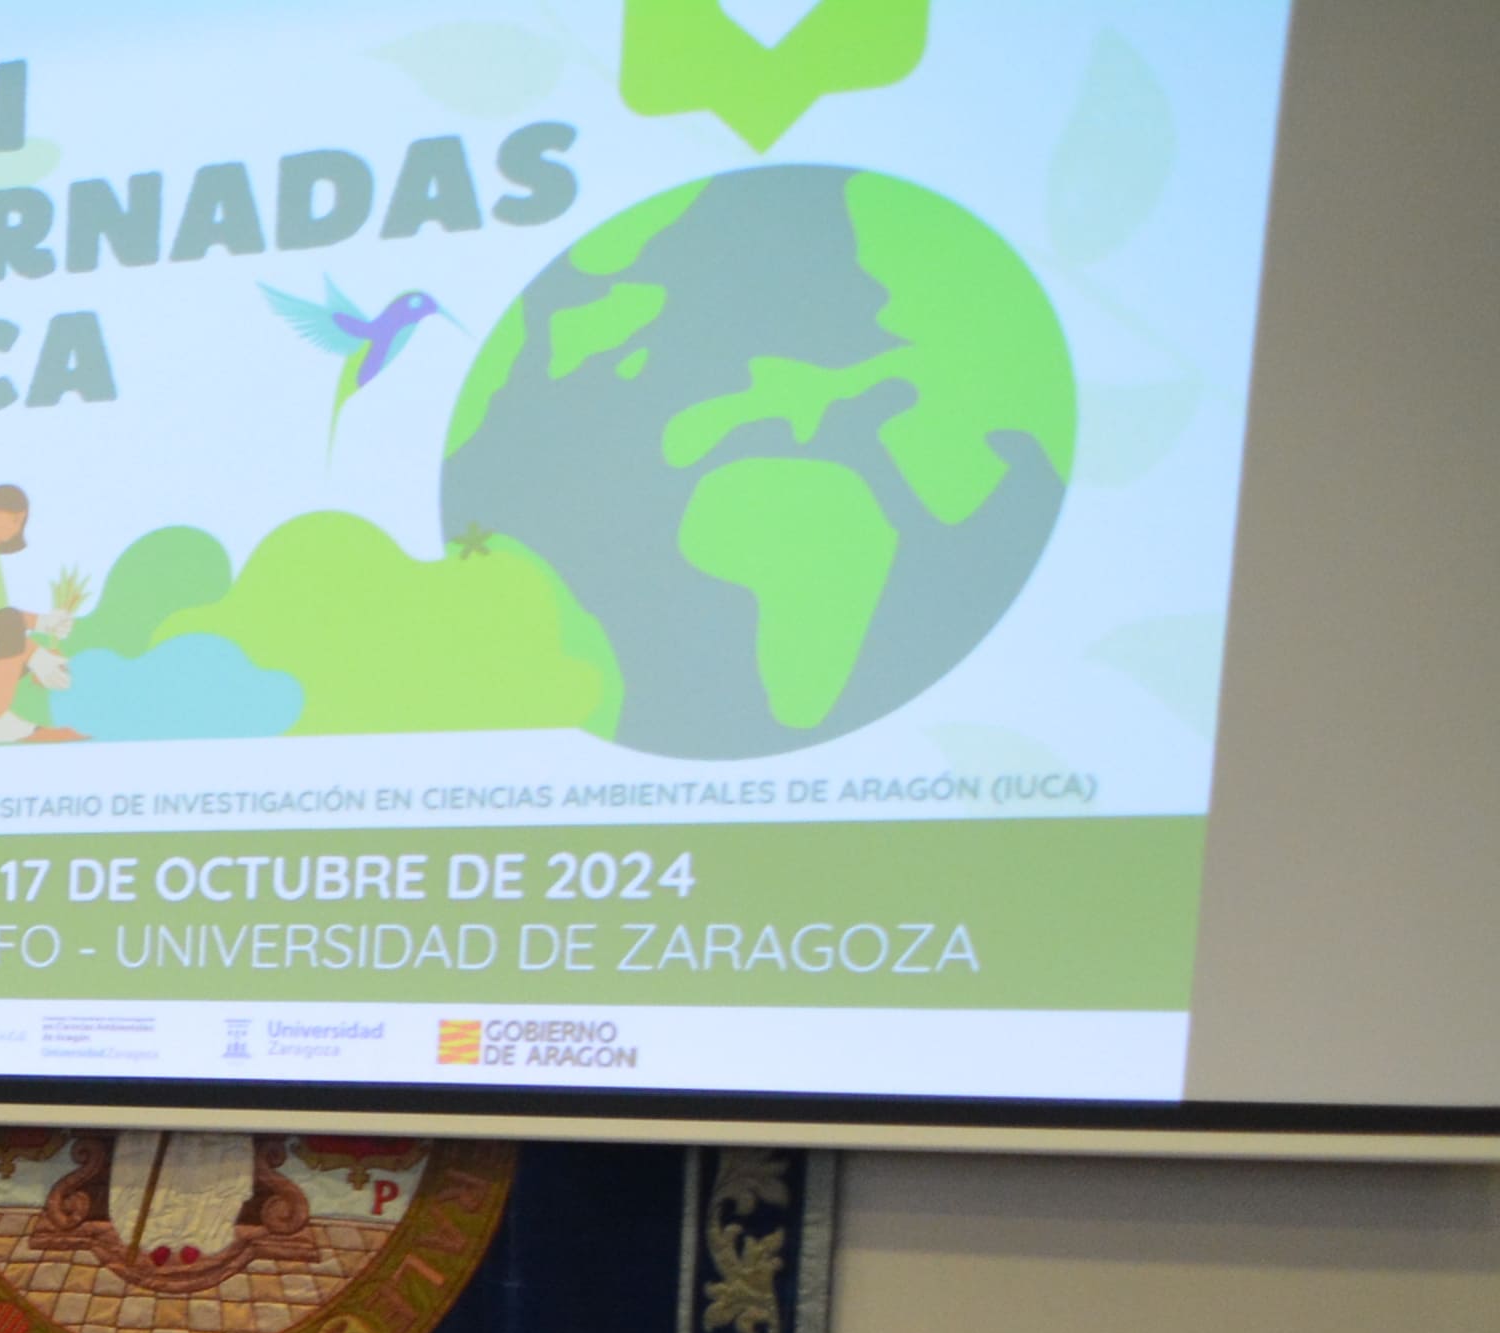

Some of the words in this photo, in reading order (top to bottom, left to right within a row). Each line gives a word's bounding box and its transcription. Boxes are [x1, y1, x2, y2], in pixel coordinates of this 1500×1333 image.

[110, 793, 145, 816] DE
[153, 785, 367, 815] INVESTIGACIÓN
[375, 788, 413, 811] EN
[422, 786, 553, 810] CIENCIAS
[561, 781, 775, 808] AMBIENTALES
[788, 780, 829, 804] DE
[838, 771, 983, 803] ARAGÓN
[990, 774, 1098, 803] (IUCA)
[68, 857, 138, 902] DE
[155, 854, 428, 901] OCTUBRE
[447, 852, 526, 899] DE
[544, 851, 697, 899] 2024
[116, 922, 497, 971] UNIVERSIDAD
[518, 923, 597, 972] DE
[616, 922, 982, 974] ZARAGOZA
[267, 1019, 386, 1040] Universidad
[485, 1020, 618, 1044] GOBIERNO
[484, 1044, 516, 1067] DE
[371, 1179, 399, 1215] P
